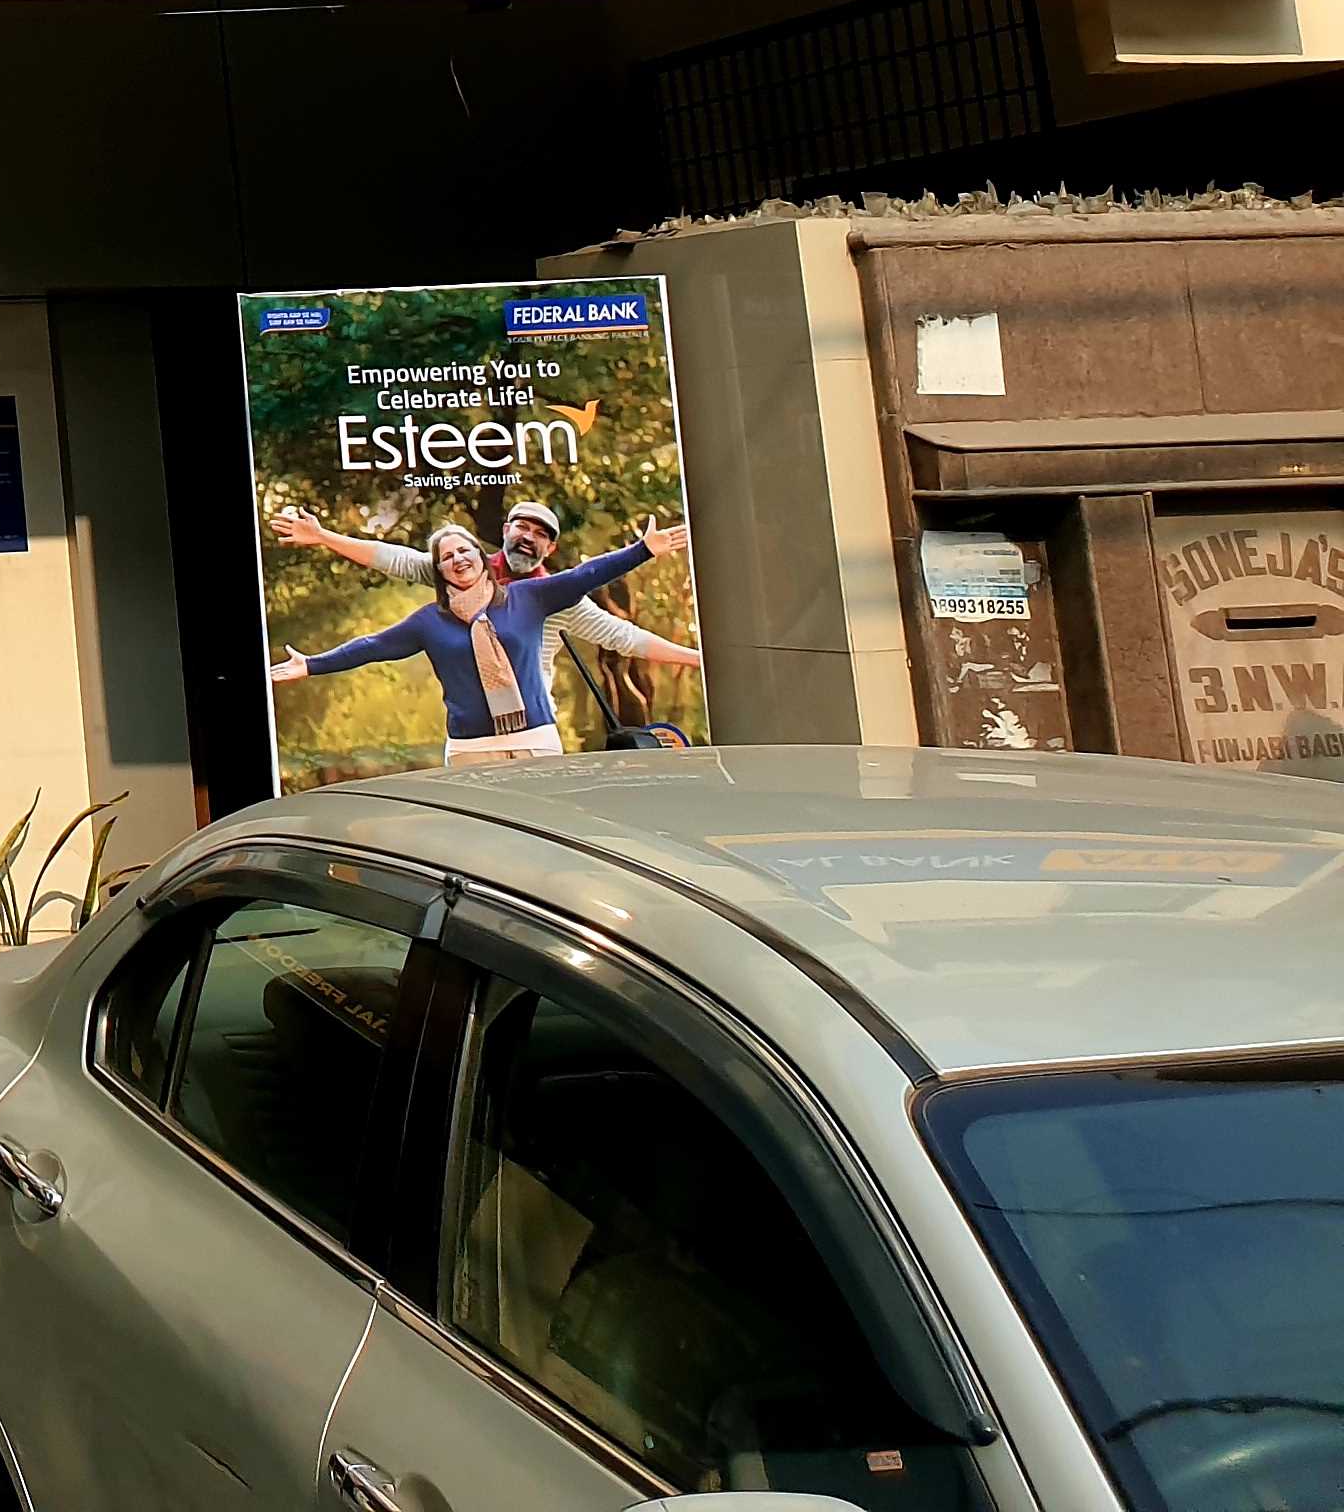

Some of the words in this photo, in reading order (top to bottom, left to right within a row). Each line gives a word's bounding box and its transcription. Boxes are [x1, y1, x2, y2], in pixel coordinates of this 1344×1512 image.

[513, 305, 585, 325] FEDERAL
[588, 301, 639, 321] BANK
[348, 361, 486, 387] Empowering
[490, 360, 531, 380] You
[536, 359, 561, 378] to
[377, 388, 482, 410] Celebrate
[488, 385, 534, 407] Life!
[337, 413, 579, 471] Esteem
[403, 473, 461, 490] Savings
[463, 471, 522, 487] Account
[1294, 732, 1344, 759] BAG
